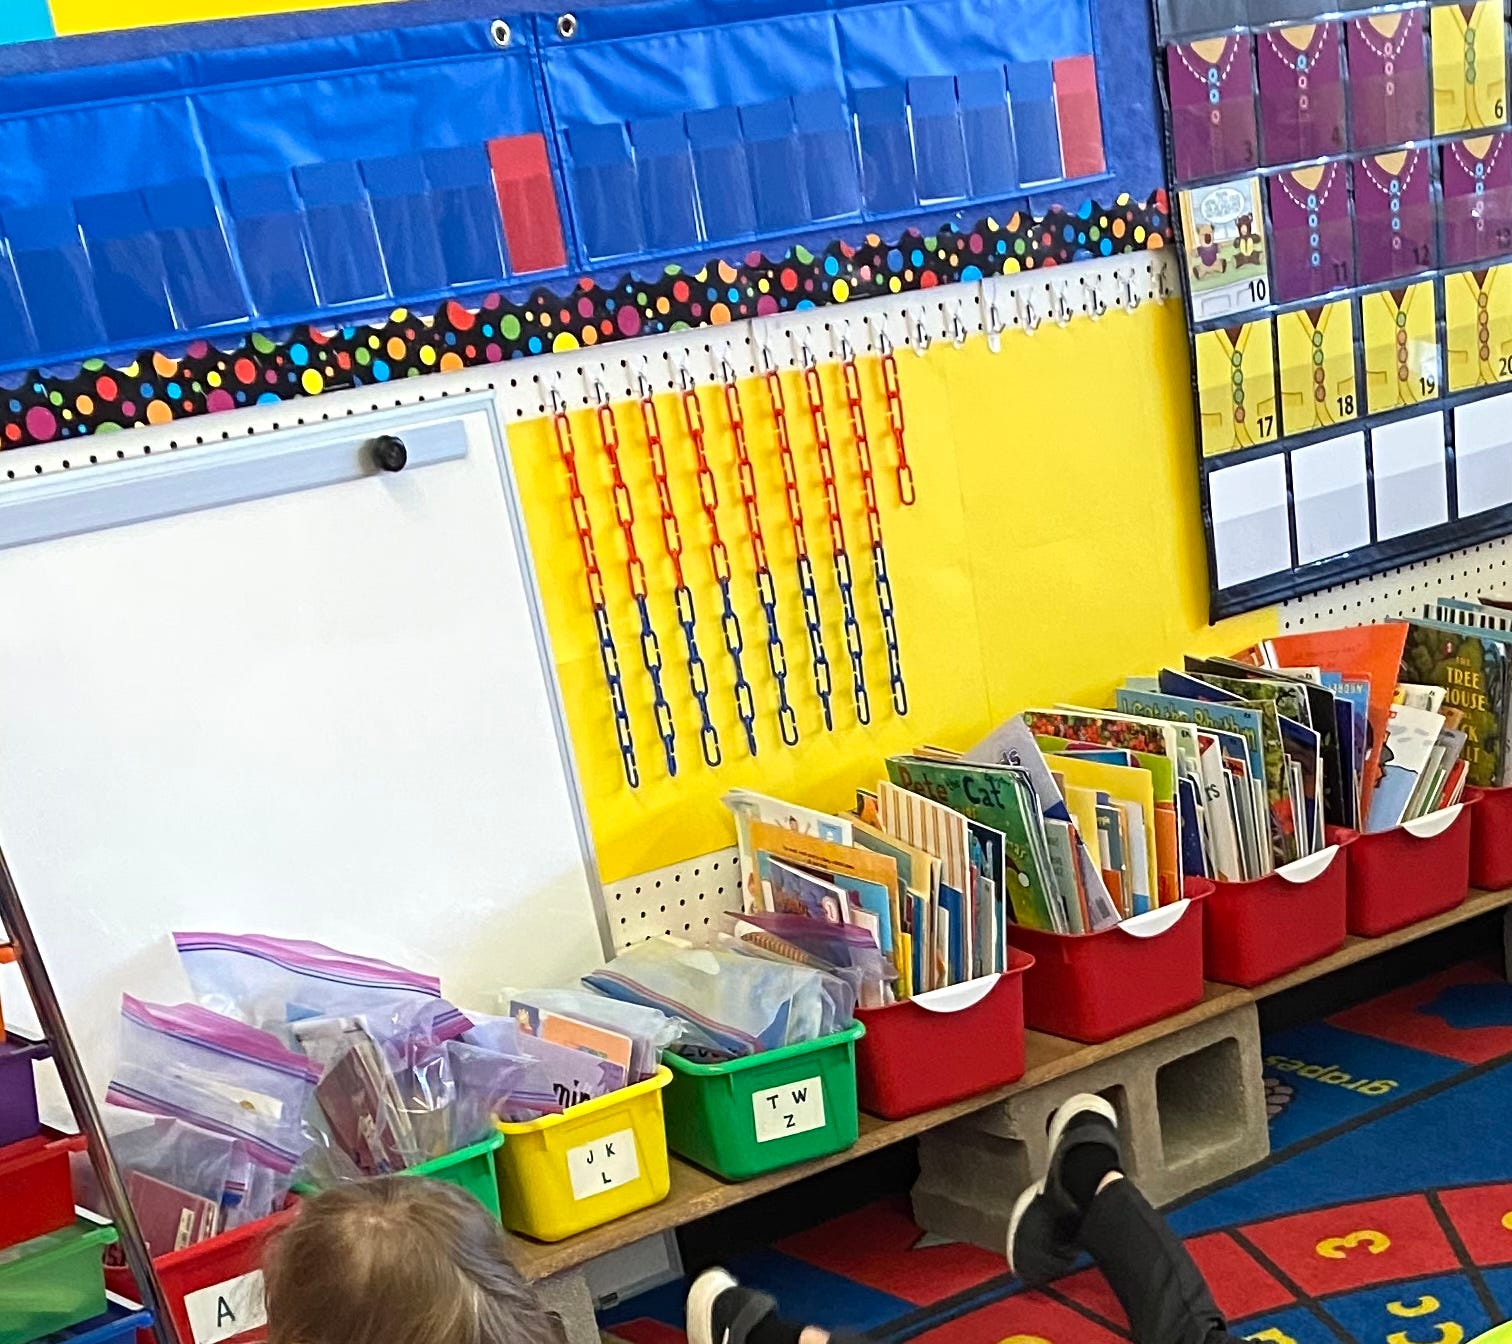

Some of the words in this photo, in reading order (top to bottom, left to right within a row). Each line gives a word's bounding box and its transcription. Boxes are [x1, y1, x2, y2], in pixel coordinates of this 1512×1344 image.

[1494, 99, 1504, 119] 6
[1249, 279, 1267, 303] 10
[1419, 376, 1435, 397] 19
[1336, 394, 1354, 417] 18
[1256, 415, 1273, 439] 17
[1446, 666, 1481, 690] TREE
[897, 764, 949, 801] Pete
[962, 774, 1006, 810] Cat
[1264, 1054, 1399, 1097] grapes
[766, 1095, 779, 1110] T
[792, 1087, 808, 1105] W
[783, 1114, 796, 1128] Z
[586, 1149, 595, 1165] J
[605, 1142, 616, 1159] K
[602, 1171, 612, 1185] L
[1315, 1229, 1392, 1259] 3
[216, 1295, 236, 1328] A
